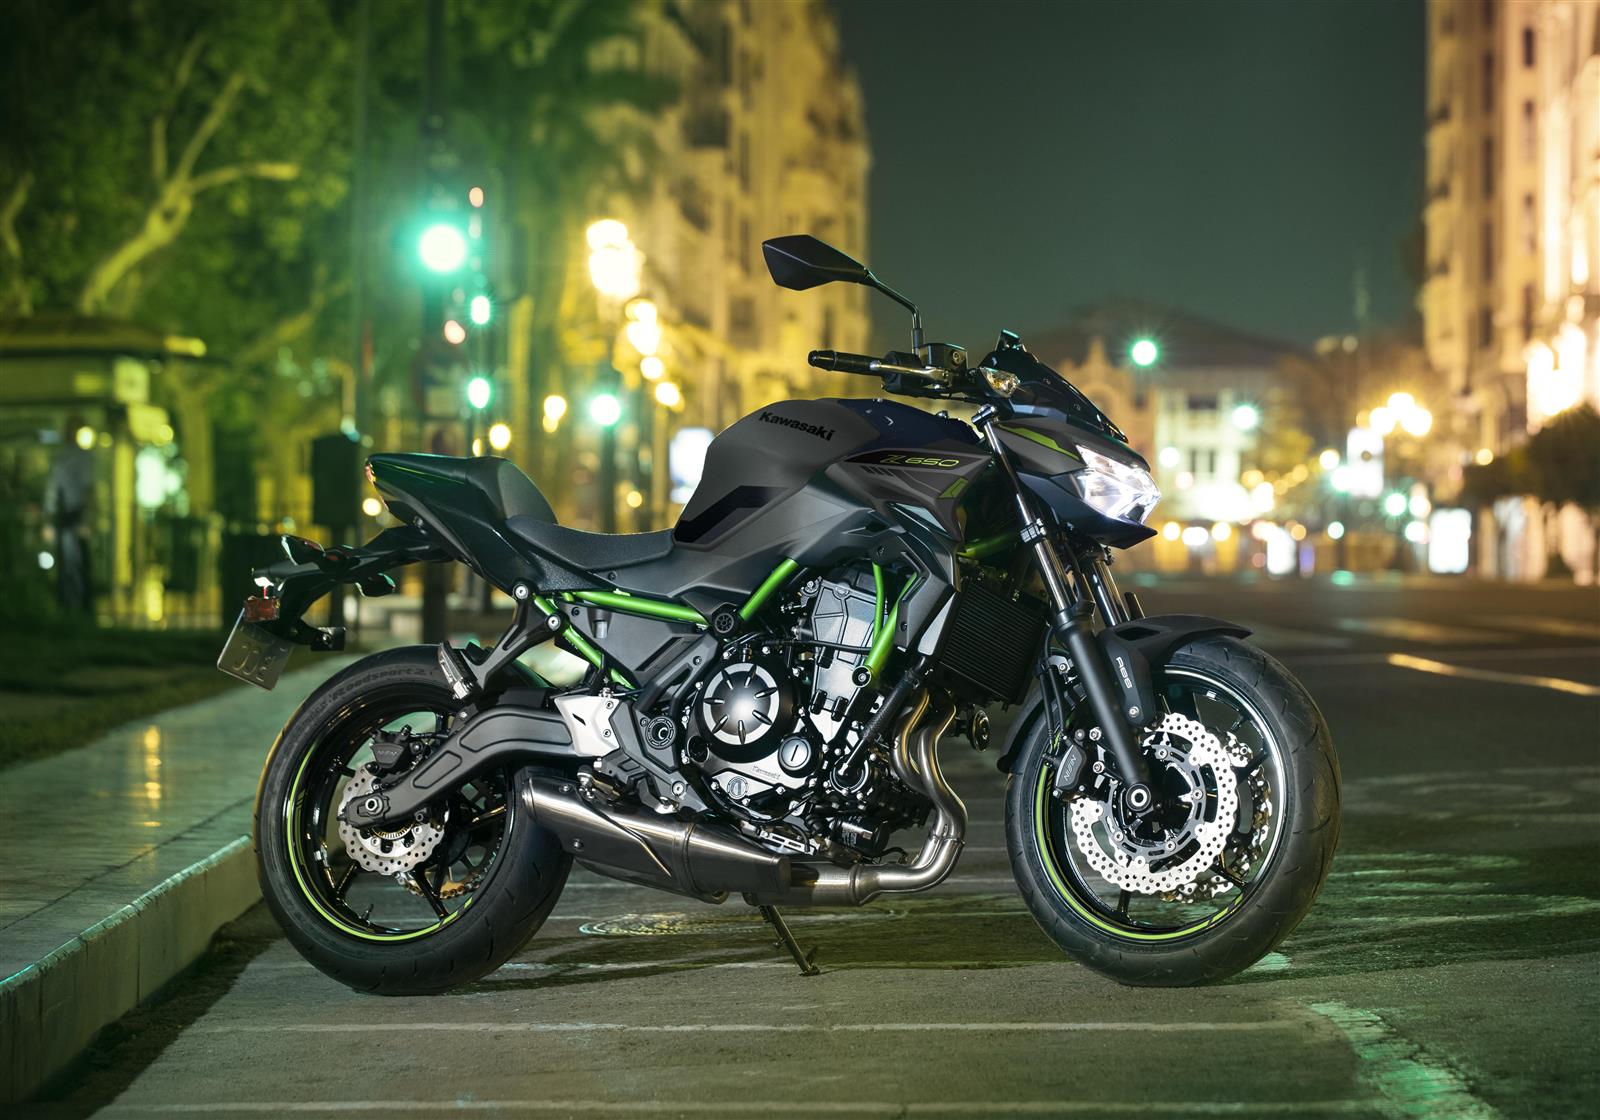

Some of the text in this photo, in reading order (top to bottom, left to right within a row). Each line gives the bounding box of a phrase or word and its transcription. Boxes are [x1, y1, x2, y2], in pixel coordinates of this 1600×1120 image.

[758, 411, 835, 442] Kawasaki
[880, 454, 960, 467] Z650
[1115, 656, 1133, 689] ABS
